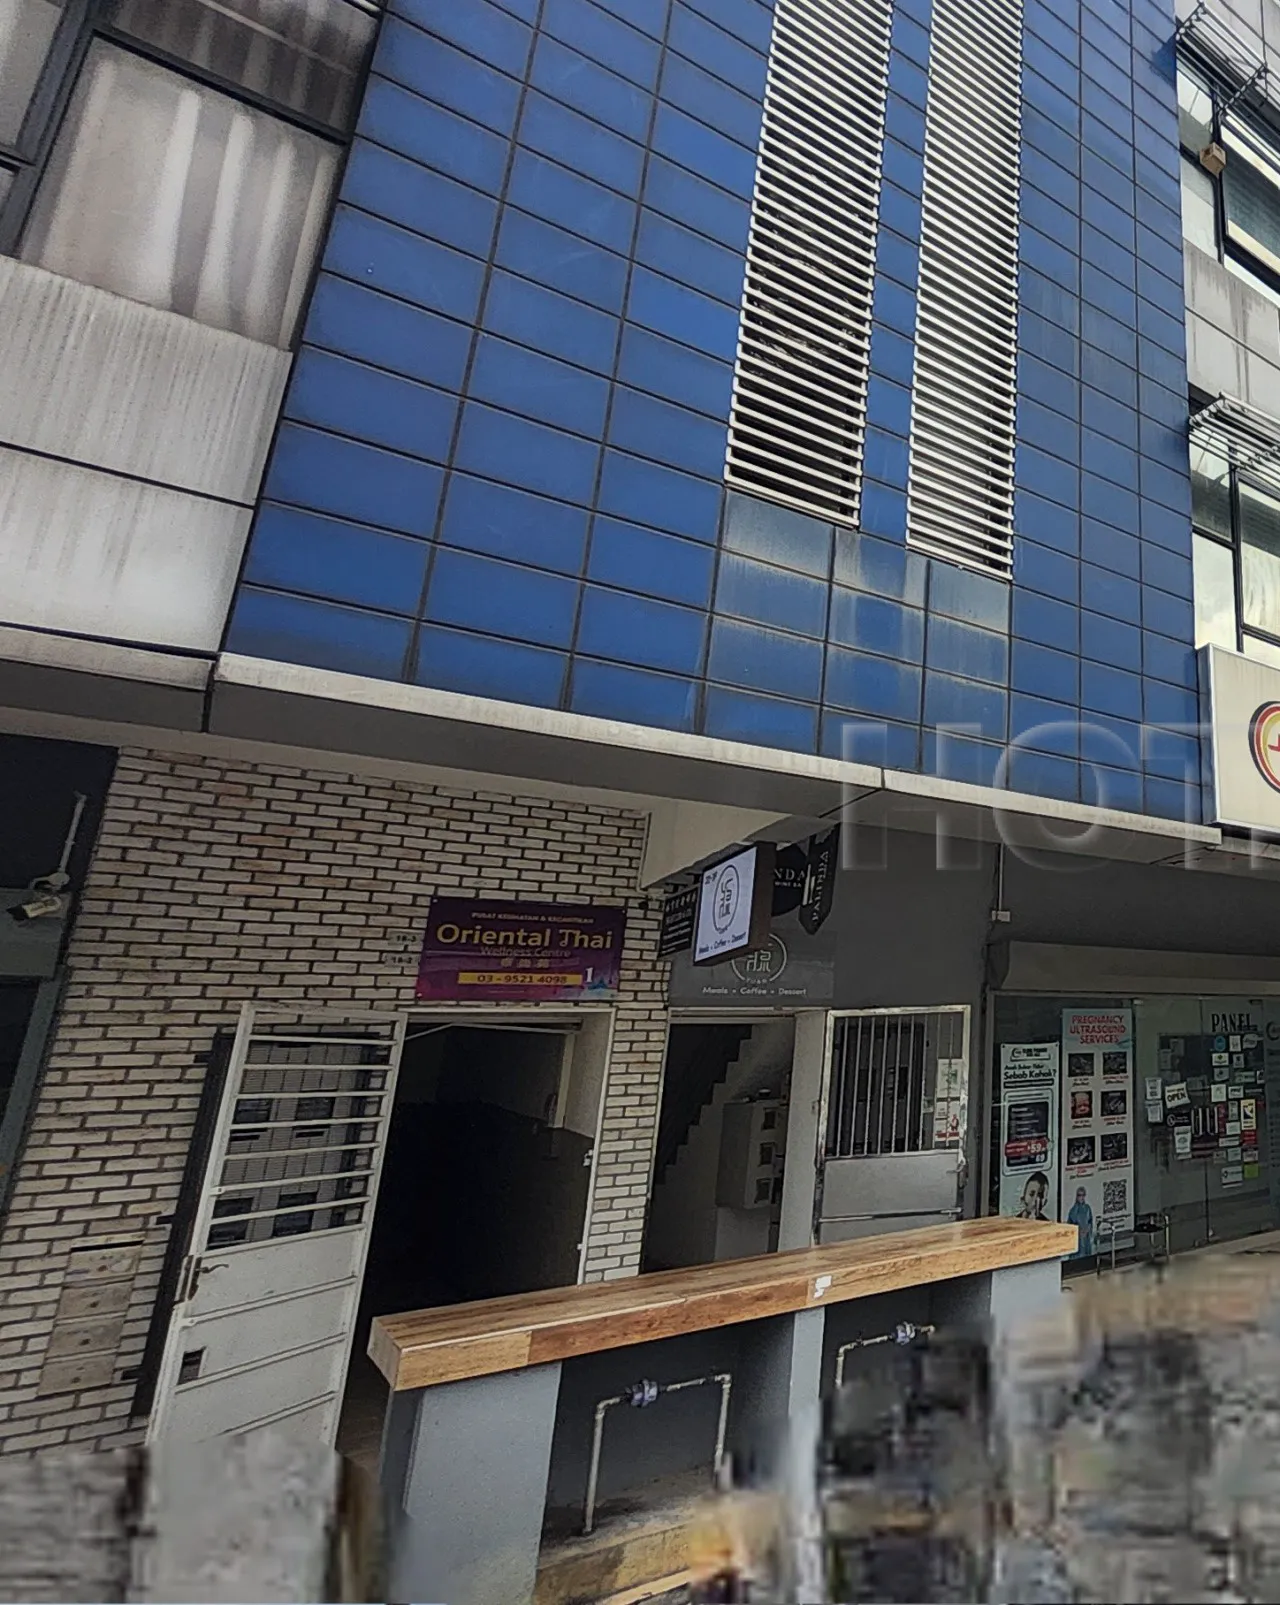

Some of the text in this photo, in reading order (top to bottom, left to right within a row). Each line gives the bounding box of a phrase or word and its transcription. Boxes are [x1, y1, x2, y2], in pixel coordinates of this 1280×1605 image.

[436, 923, 613, 949] Oriental Thai
[480, 945, 572, 958] Wellness Centre
[740, 986, 767, 995] Coffee
[778, 987, 807, 996] Dessert
[1072, 1015, 1124, 1024] PREGNANCY
[1211, 1013, 1253, 1032] PANEL
[1070, 1024, 1126, 1034] ULTRASOUND
[1080, 1034, 1120, 1044] SERVICES
[1167, 1091, 1186, 1102] OPEN
